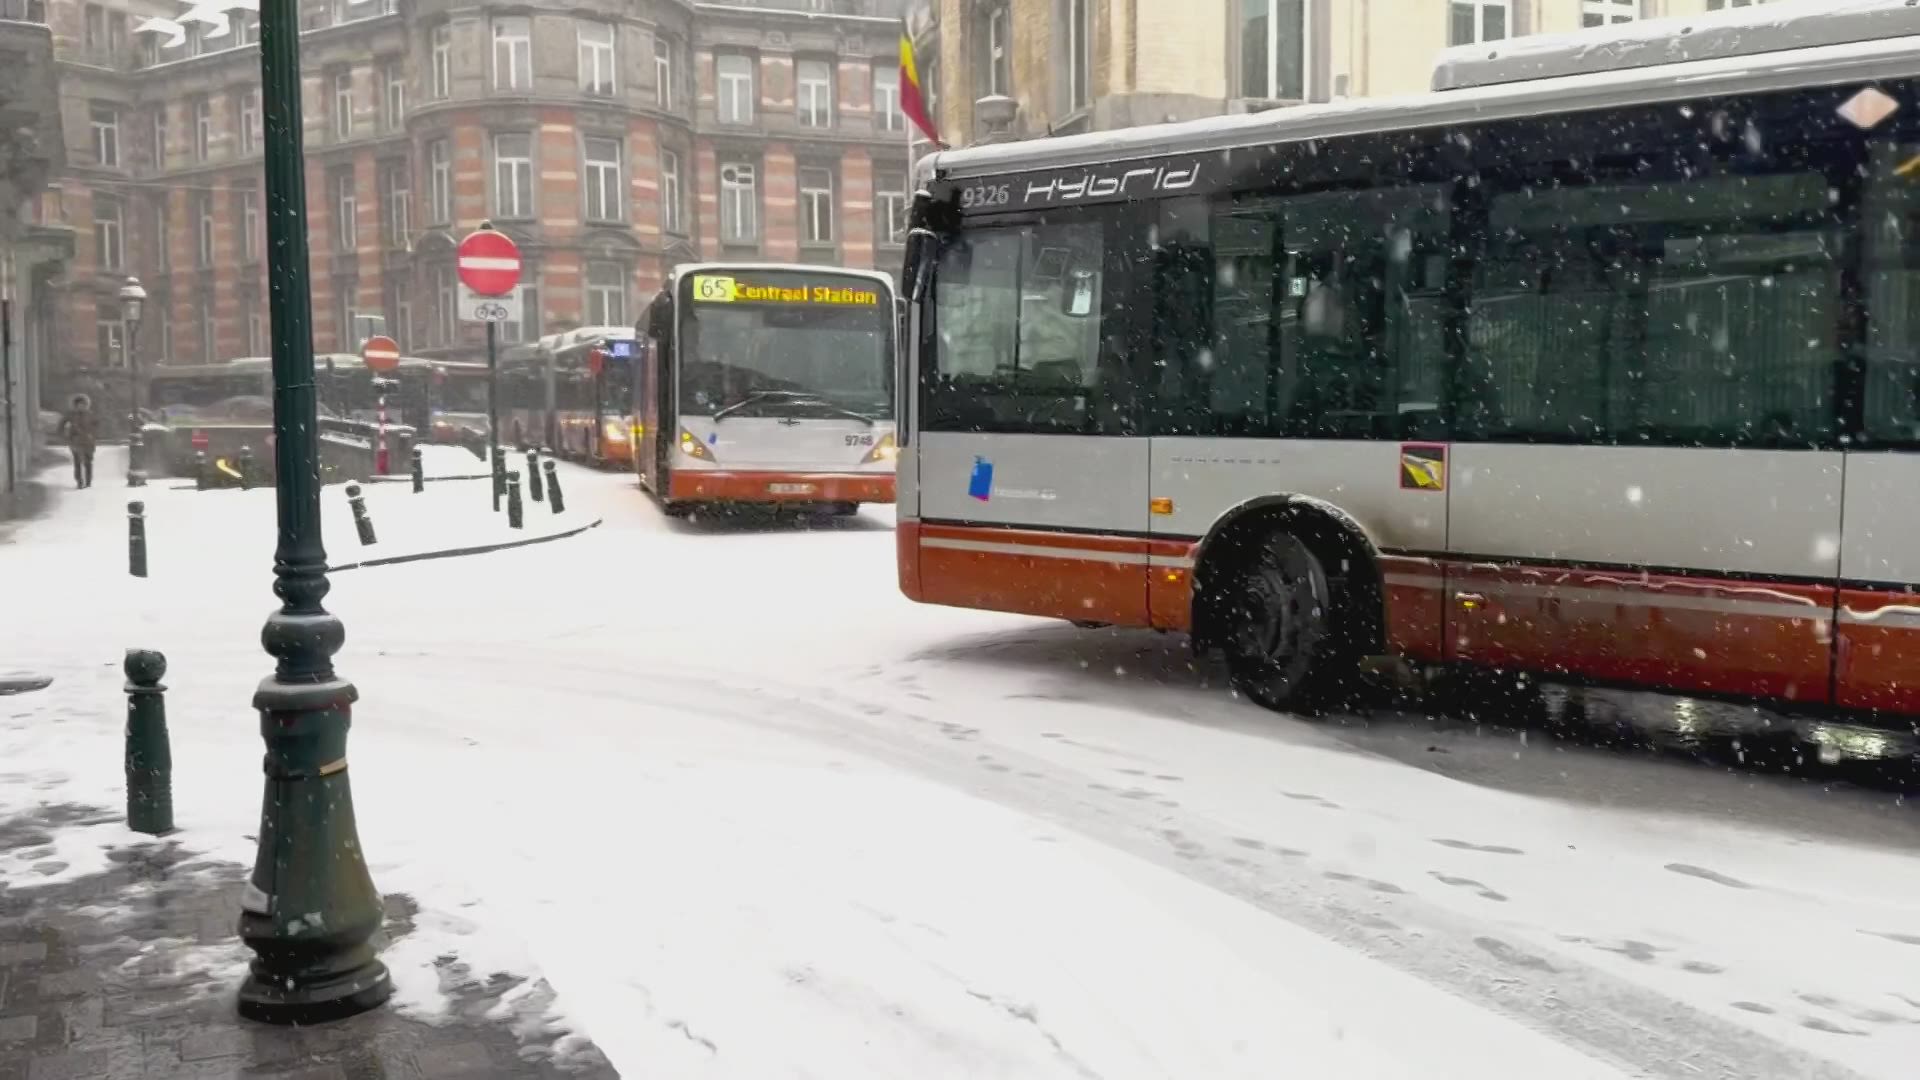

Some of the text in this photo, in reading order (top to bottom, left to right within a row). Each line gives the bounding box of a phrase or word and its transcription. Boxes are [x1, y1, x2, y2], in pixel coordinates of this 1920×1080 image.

[961, 184, 1010, 209] 9326
[700, 279, 728, 299] 65
[734, 282, 877, 305] Centraal Station
